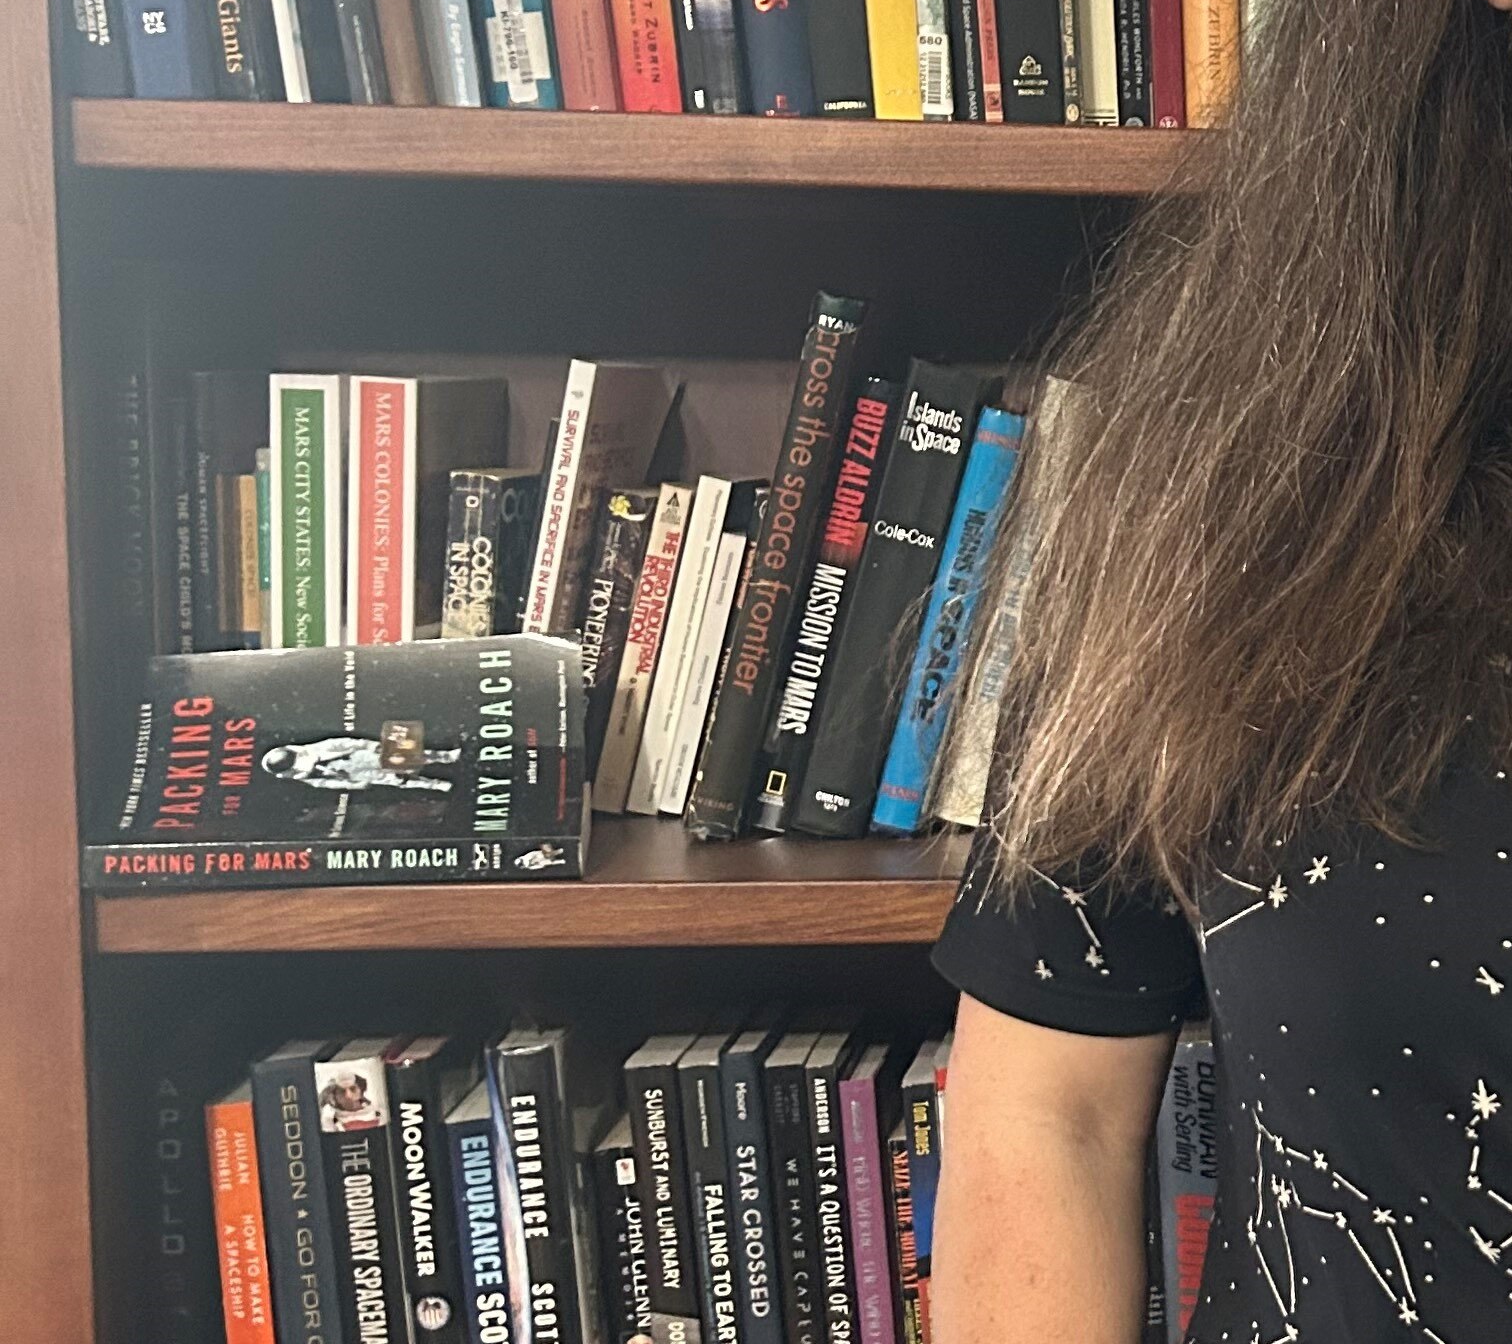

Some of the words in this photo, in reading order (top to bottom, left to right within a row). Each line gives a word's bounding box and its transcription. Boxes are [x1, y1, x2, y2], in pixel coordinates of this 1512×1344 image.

[843, 396, 888, 459] BUZZ
[900, 418, 914, 441] in
[911, 424, 961, 455] Space
[907, 392, 963, 433] Islands
[822, 458, 873, 546] ALDRIN
[874, 520, 935, 549] Cole-Cox
[798, 562, 846, 650] MISSION
[791, 648, 824, 677] TO
[475, 649, 516, 761] ROACH
[775, 676, 817, 735] MARS
[154, 695, 214, 829] PACKING
[219, 715, 257, 787] MARS
[472, 776, 511, 832] MARY
[104, 854, 193, 874] PACKING
[204, 853, 243, 873] FOR
[253, 851, 308, 870] MARS
[326, 849, 380, 870] MARY
[390, 847, 457, 868] ROACH
[280, 1084, 308, 1199] SEDDON
[340, 1137, 371, 1172] THE
[643, 1088, 669, 1172] SUNBURST
[509, 1094, 549, 1239] ENDURANCE
[654, 1174, 670, 1201] AND
[734, 1144, 758, 1201] STAR
[815, 1145, 837, 1177] IT'S
[818, 1183, 838, 1194] A
[343, 1172, 379, 1263] ORDINARY
[459, 1134, 502, 1286] ENDURANCE
[704, 1183, 729, 1267] FALLING
[294, 1227, 314, 1266] GO
[655, 1206, 681, 1289] LUMINARY
[741, 1208, 770, 1318] CROSSED
[820, 1199, 846, 1287] QUESTION
[298, 1273, 321, 1328] FOR
[712, 1270, 731, 1296] TO
[827, 1293, 848, 1315] OF
